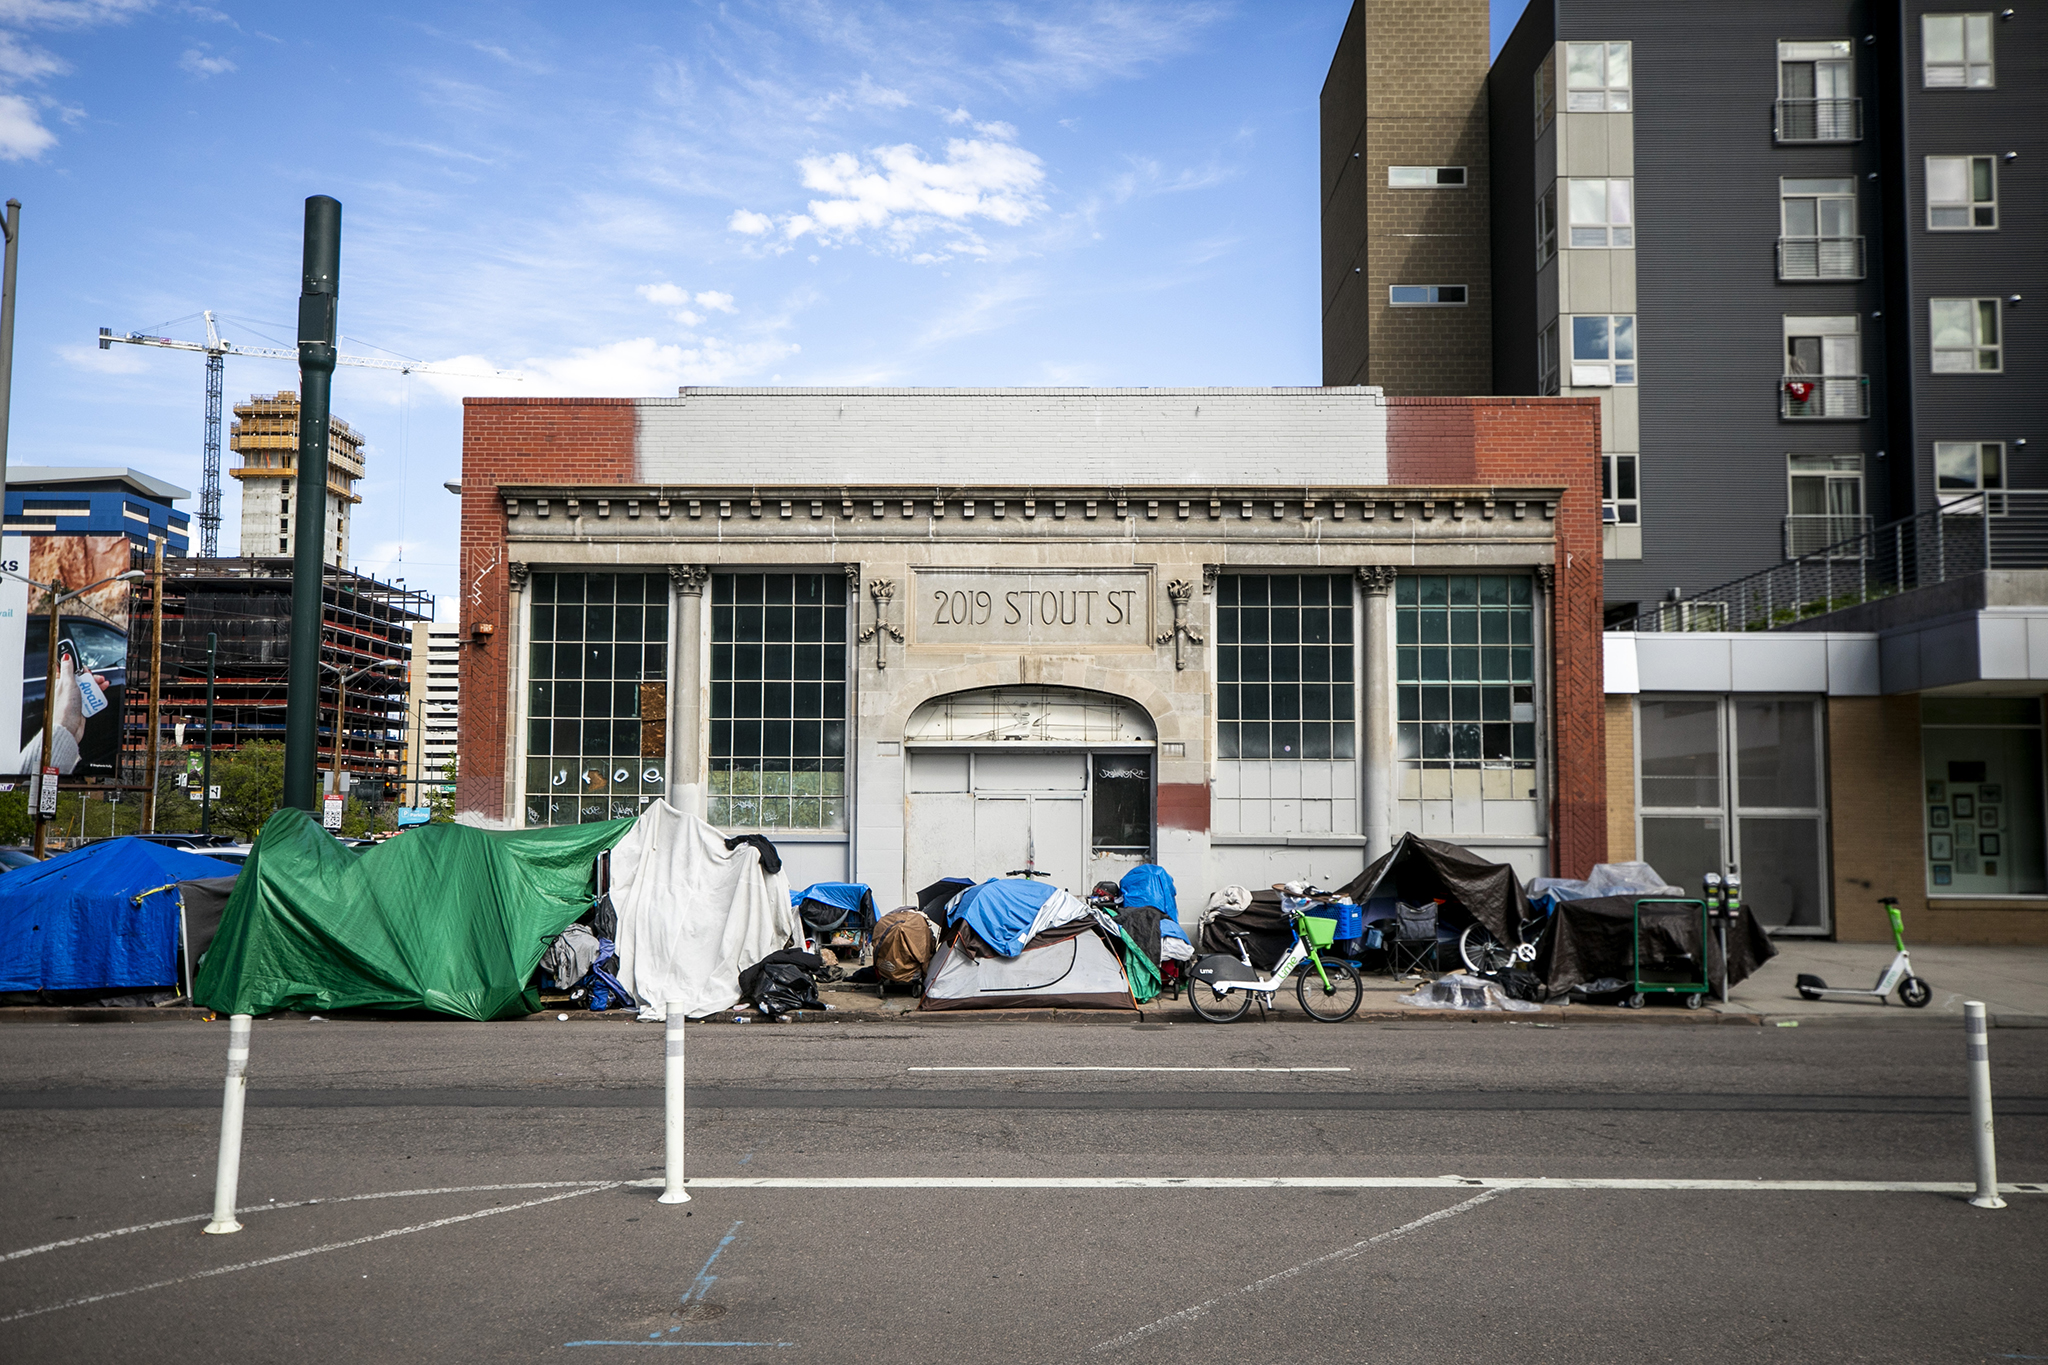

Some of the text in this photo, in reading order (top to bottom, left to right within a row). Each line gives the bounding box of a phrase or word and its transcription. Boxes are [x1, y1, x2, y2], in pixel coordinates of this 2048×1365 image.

[933, 590, 1137, 626] 2019 STOUT ST
[79, 681, 104, 711] Avail
[1277, 956, 1298, 979] Lime
